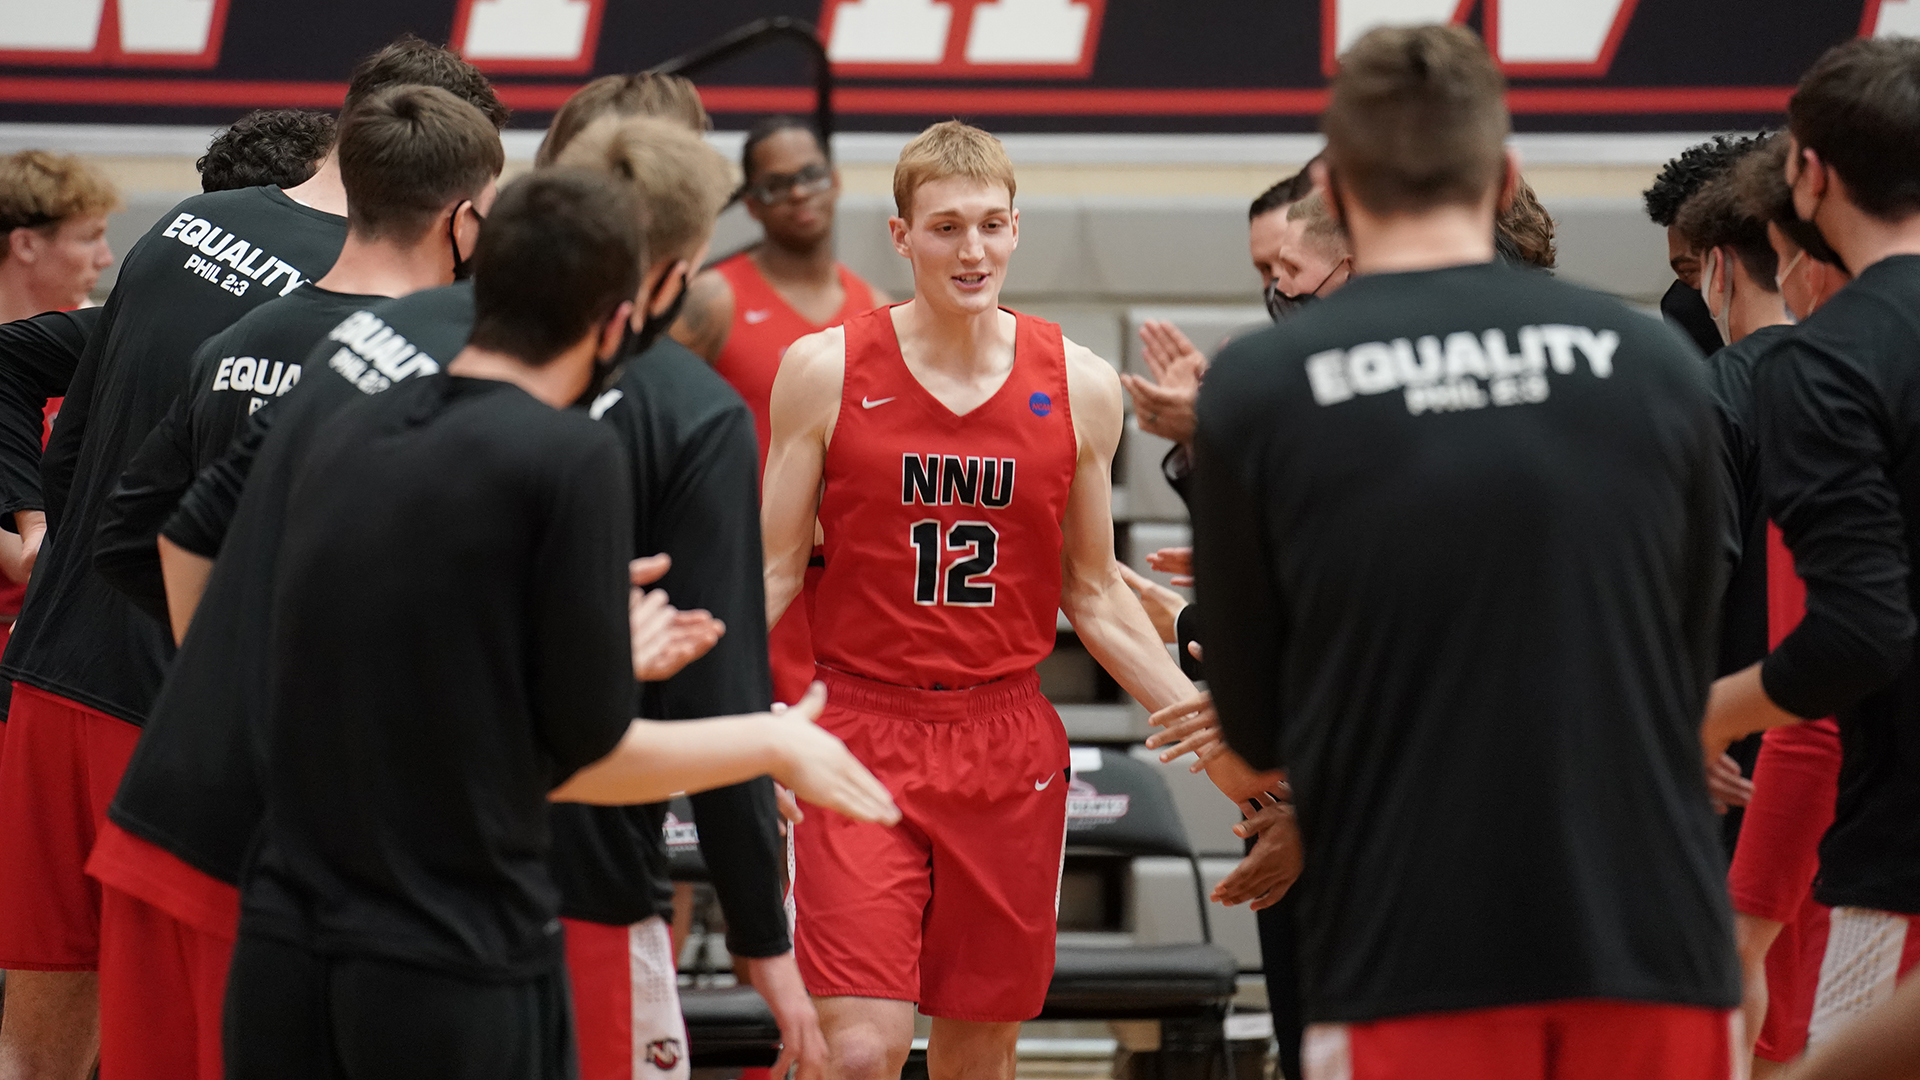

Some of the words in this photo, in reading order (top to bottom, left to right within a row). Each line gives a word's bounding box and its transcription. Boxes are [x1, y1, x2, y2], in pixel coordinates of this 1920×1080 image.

[162, 212, 312, 297] EQUALITY
[183, 253, 222, 285] PHIL
[220, 273, 250, 297] 2:3
[212, 356, 302, 397] EQUA
[327, 310, 440, 383] EQUALIT
[1305, 323, 1620, 407] EQUALITY
[902, 453, 1015, 509] NNU
[910, 518, 999, 607] 12
